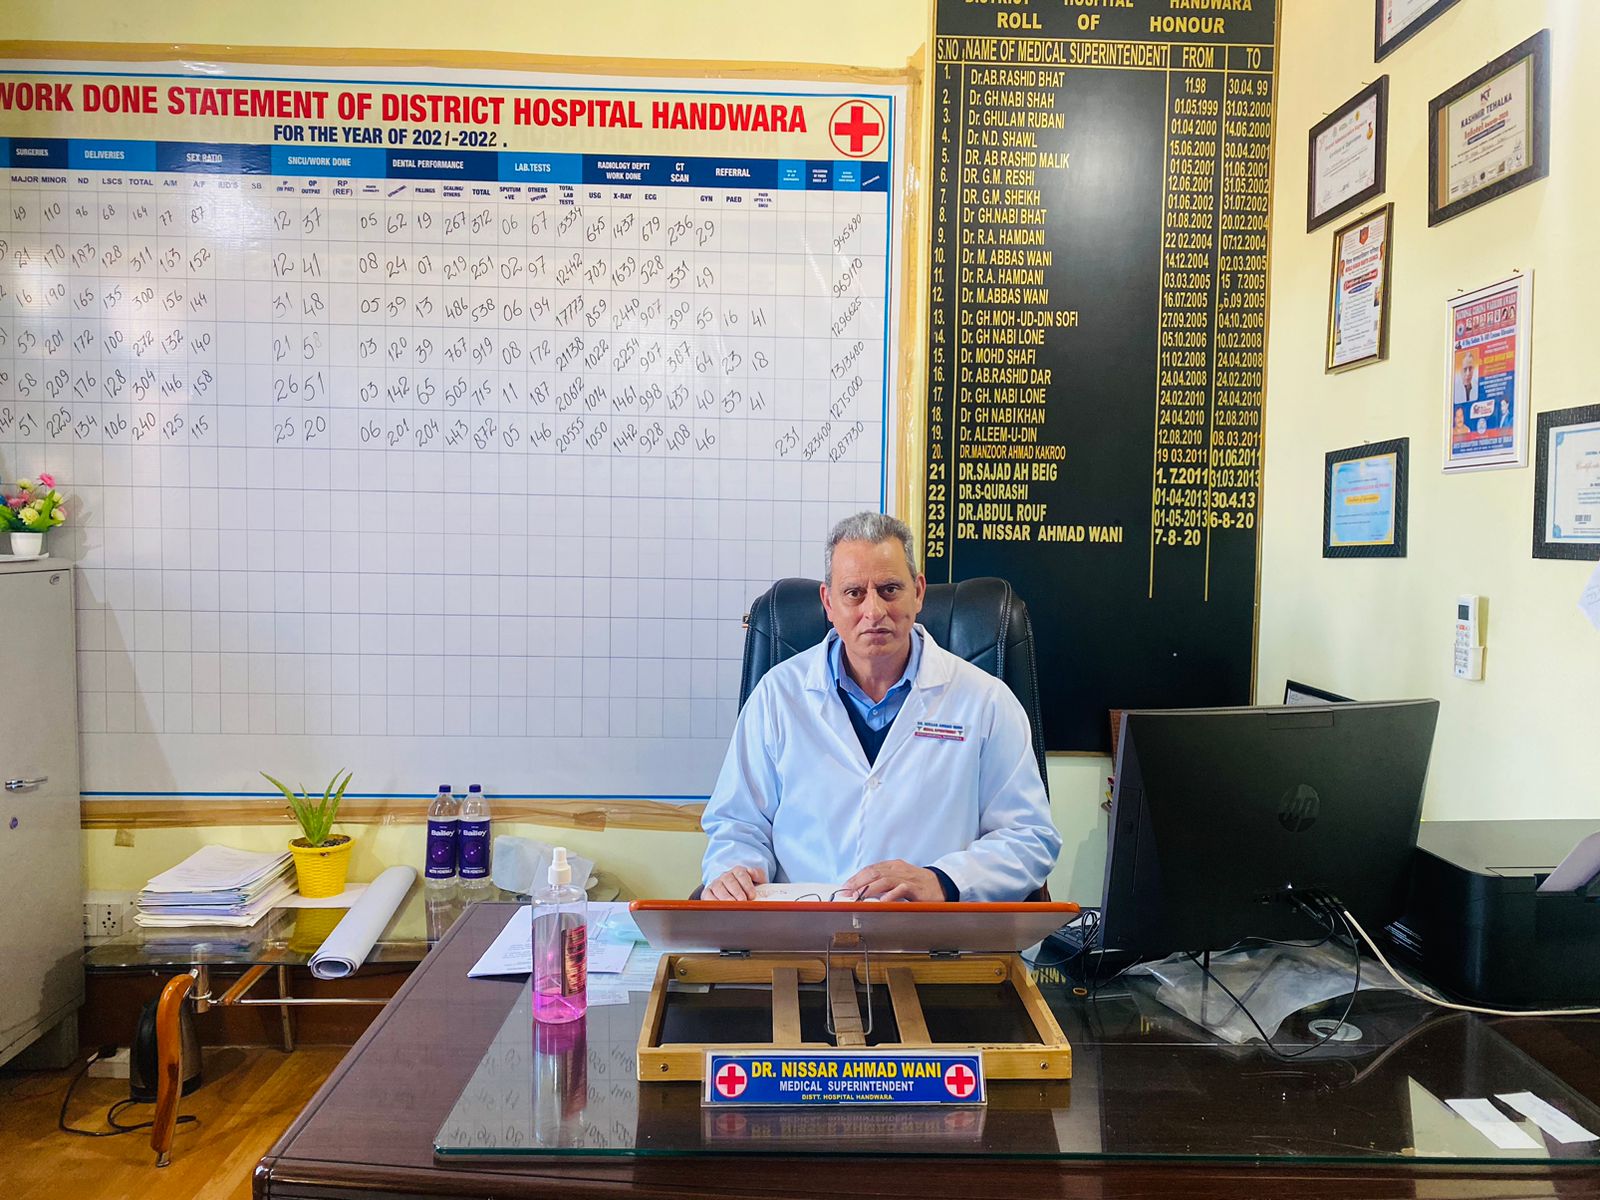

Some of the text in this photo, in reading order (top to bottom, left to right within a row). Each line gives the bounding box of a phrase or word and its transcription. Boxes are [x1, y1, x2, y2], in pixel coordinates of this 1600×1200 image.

[997, 12, 1225, 33] ROLL OF HONOUR
[937, 38, 1261, 69] S.NO NAME OF MEDICAL SUPERINTENDENT FROM TO
[1038, 72, 1065, 88] BHAT
[0, 82, 807, 133] WORK DONE STATEMENT OF DISTRICT HOSPITAL HANDWARA
[969, 90, 981, 105] Dr.
[1027, 93, 1055, 108] SHAH
[1226, 101, 1271, 118] 31.03.2000
[968, 111, 1065, 129] Dr. GHULAM RUBANI
[273, 124, 304, 142] FOR
[308, 126, 338, 143] THE
[342, 127, 383, 144] YEAR
[388, 128, 408, 145] OF
[967, 129, 979, 145] Dr.
[982, 130, 1000, 146] N.D.
[1002, 131, 1037, 148] SHAWL
[1170, 140, 1215, 157] 15.06.2000
[16, 148, 49, 157] SURGERIES
[84, 150, 125, 160] DELIVERIES
[186, 153, 223, 163] SEX RATIO
[288, 156, 351, 167] SNCU/WORK DONE
[392, 159, 464, 169] DENTAL PERFORMANCE
[597, 161, 630, 170] RADIOLOGY
[675, 163, 684, 171] CT
[41, 176, 67, 184] MINOR
[129, 178, 153, 186] TOTAL
[606, 172, 641, 181] WORK DONE
[671, 173, 689, 183] SCAN
[715, 168, 750, 177] REFERRAL
[963, 168, 980, 184] DR.
[983, 168, 1002, 185] G.M.
[1005, 169, 1035, 186] RESHI
[1168, 176, 1213, 192] 12.06.2001
[963, 189, 980, 204] DR.
[982, 189, 1002, 205] G.M.
[1005, 189, 1041, 206] SHEIKH
[1168, 194, 1214, 210] 01.06.2002
[75, 205, 89, 217] 96
[102, 204, 115, 221] 68
[274, 210, 291, 231] 12
[361, 212, 378, 229] 05
[387, 213, 407, 234] 62
[417, 212, 432, 229] 19
[444, 211, 466, 235] 267
[1020, 208, 1047, 225] BHAT
[962, 228, 1045, 245] Dr. R.A. HAMDANI
[962, 248, 1053, 266] Dr. M. ABBAS WANI
[961, 348, 1036, 365] Dr. MOHD SHAFI
[961, 367, 973, 382] Dr.
[1031, 370, 1051, 384] DAR
[274, 417, 295, 444] 25
[304, 416, 326, 441] 20
[360, 420, 381, 442] 06
[695, 428, 716, 452] 46
[960, 426, 972, 441] Dr.
[1008, 446, 1033, 459] AHMAD
[1035, 446, 1066, 460] KAKROO
[930, 463, 945, 480] 21
[1013, 463, 1029, 481] AH
[1032, 463, 1058, 481] BEIG
[928, 484, 946, 501] 22
[1211, 492, 1255, 508] 30.4.13
[928, 504, 945, 520] 23
[1016, 504, 1047, 522] ROUF
[927, 523, 1123, 543] 24 DR. NISSAR AHMAD WANI
[927, 541, 944, 557] 25
[751, 1061, 942, 1078] DR. NISSAR AHMAD WANI
[779, 1080, 914, 1092] MEDICAL SUPERINTENDENT
